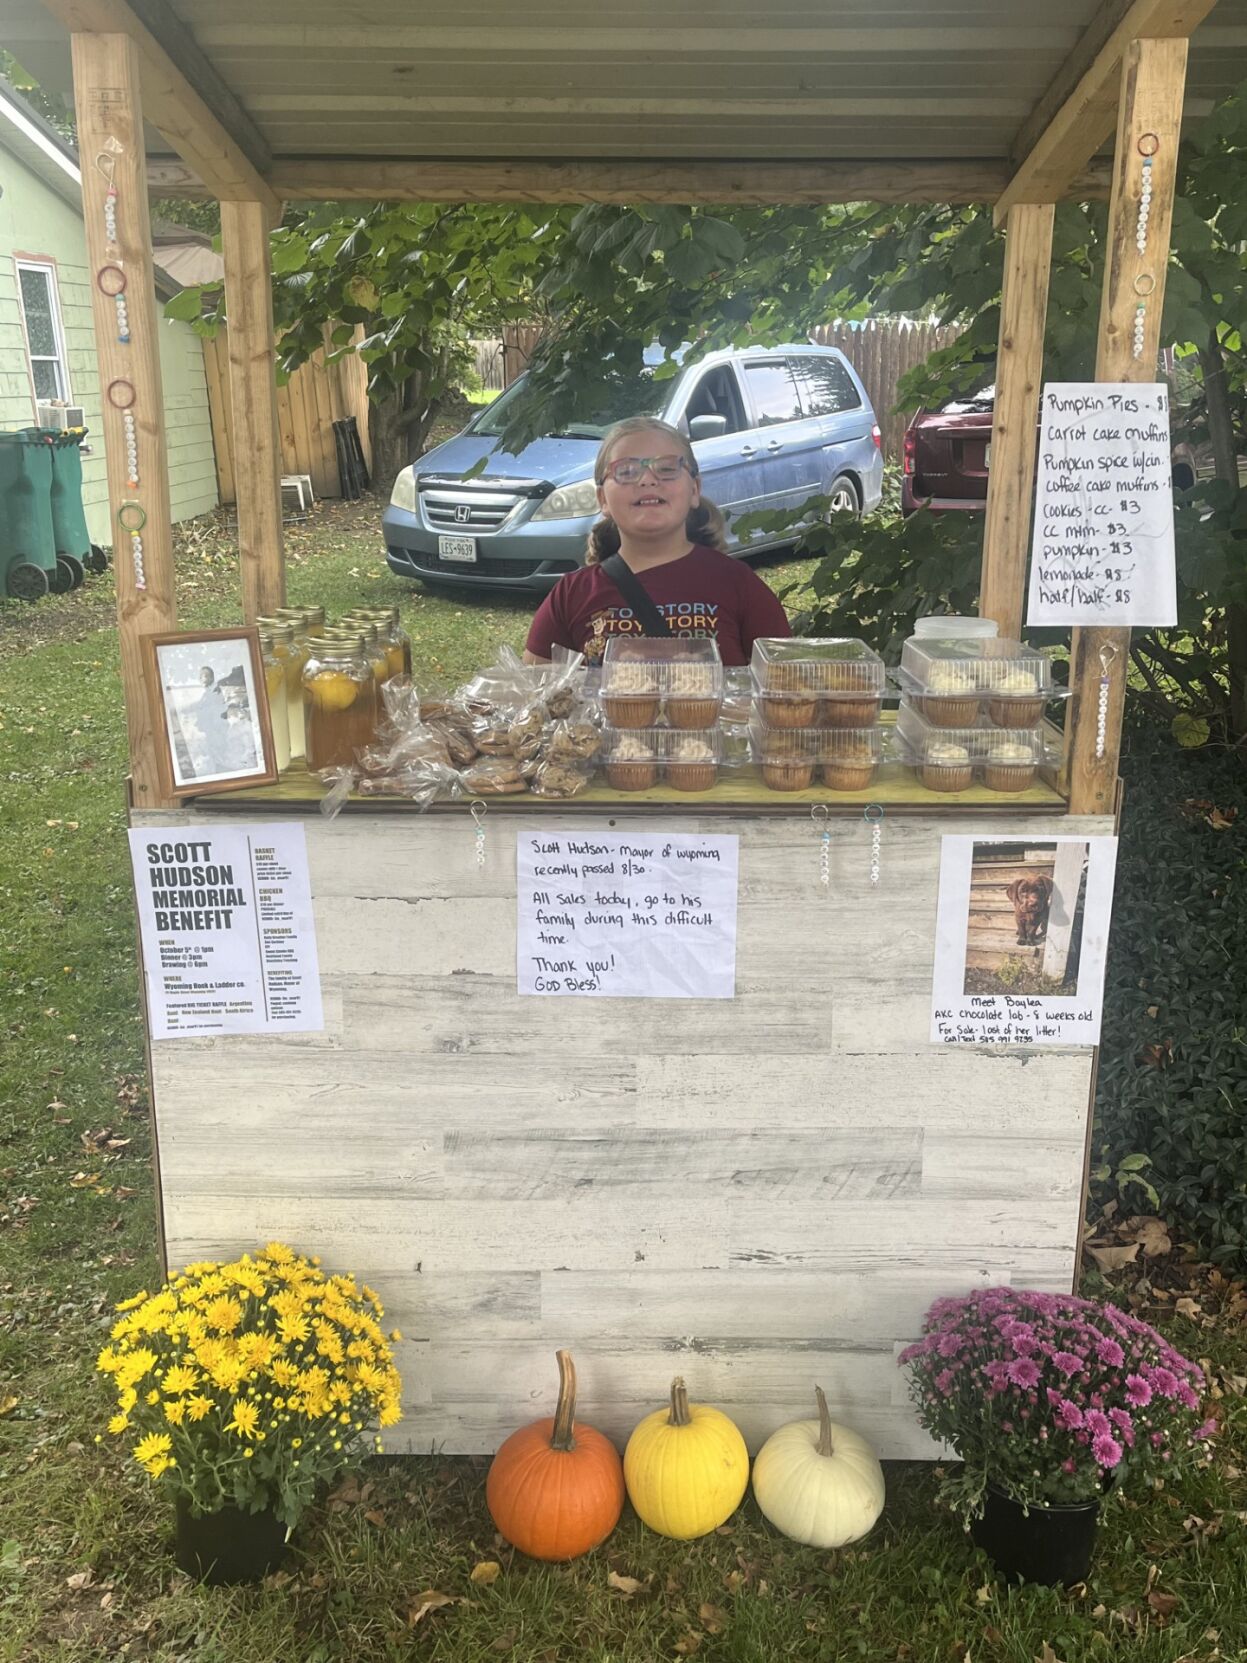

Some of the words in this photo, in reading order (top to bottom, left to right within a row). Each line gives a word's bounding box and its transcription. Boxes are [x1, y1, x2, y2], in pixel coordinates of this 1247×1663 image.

[1048, 394, 1104, 415] Pumpkin
[1108, 395, 1138, 412] Pies
[1048, 425, 1086, 440] Carrot
[1044, 454, 1094, 474] Pumpkin
[1099, 456, 1128, 472] spice
[1087, 480, 1111, 492] cake
[1117, 476, 1158, 492] muffins
[1120, 500, 1141, 514] $3
[1107, 523, 1126, 535] $3
[1044, 544, 1099, 560] pumpkin
[1110, 542, 1132, 555] $3
[608, 607, 633, 618] TO
[665, 615, 718, 629] TORY
[146, 842, 211, 864] SCOTT
[531, 840, 560, 854] Scott
[662, 843, 672, 858] of
[150, 865, 234, 887] HUDSON
[535, 864, 578, 878] recently
[582, 862, 614, 878] passed
[152, 888, 247, 908] MEMORIAL
[533, 892, 550, 904] All
[645, 896, 658, 909] go
[662, 893, 675, 904] to
[681, 893, 701, 908] his
[155, 909, 233, 931] BENEFIT
[536, 909, 575, 930] family
[584, 910, 623, 928] during
[631, 913, 657, 925] this
[665, 910, 712, 925] difficult
[532, 957, 577, 972] Thank
[586, 954, 614, 977] you!
[564, 975, 601, 991] Bless!
[935, 1010, 953, 1018] AKC
[1009, 1009, 1023, 1020] lab
[1033, 1010, 1039, 1020] 8
[1046, 1012, 1075, 1020] weeks
[1078, 1010, 1093, 1020] old
[939, 1022, 952, 1034] For
[982, 1025, 1000, 1034] last
[1004, 1023, 1012, 1034] of
[1016, 1026, 1029, 1035] her
